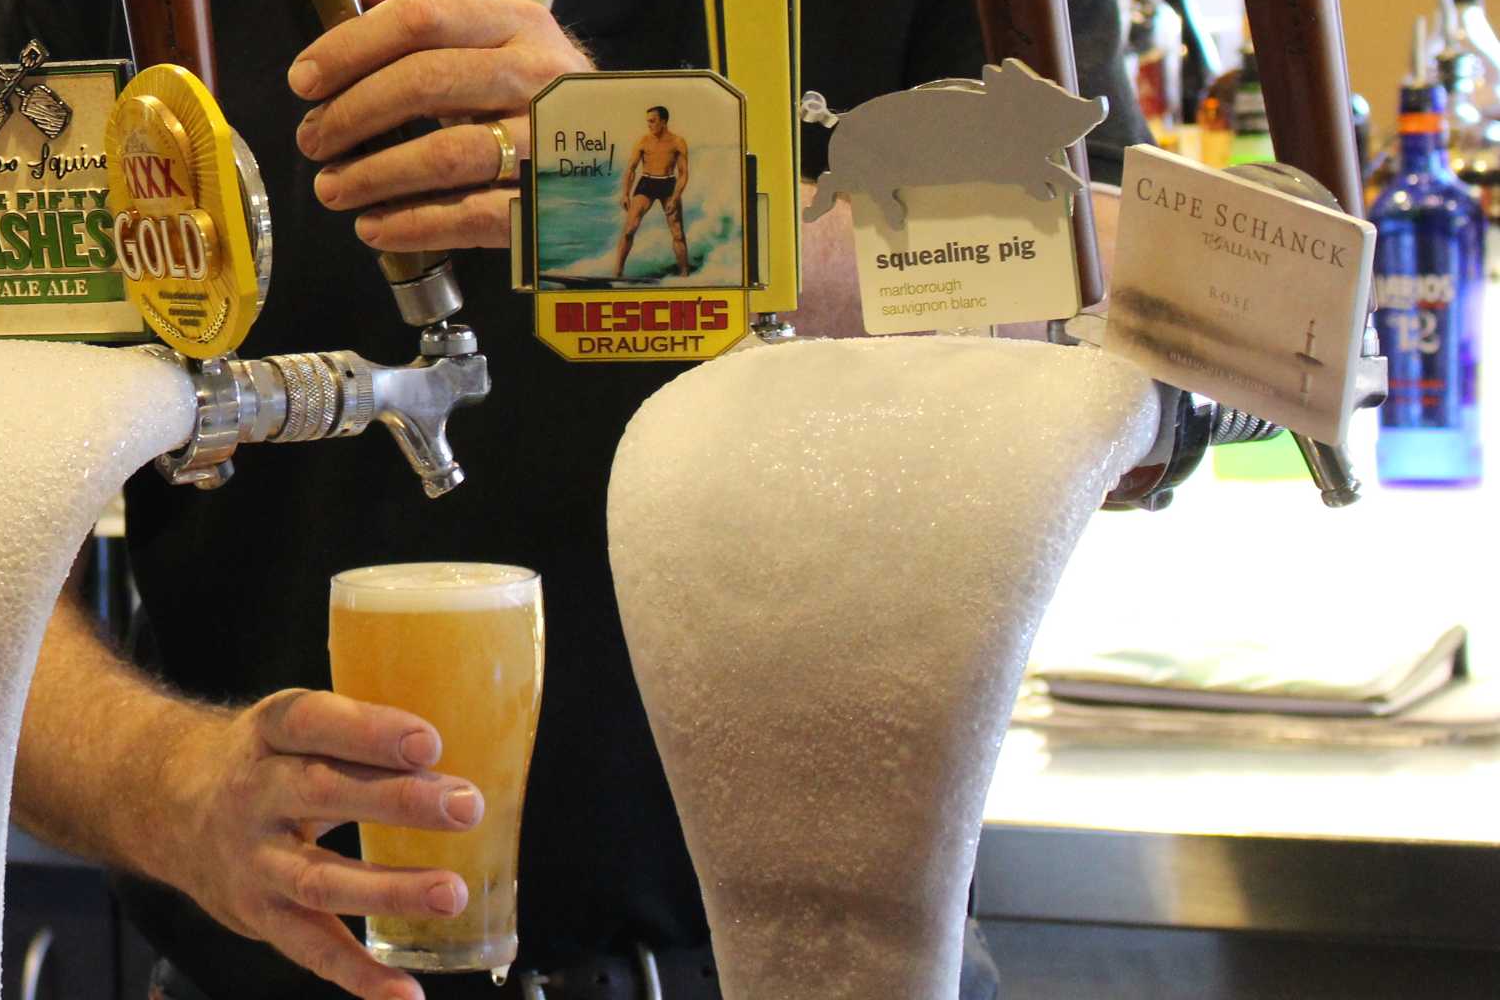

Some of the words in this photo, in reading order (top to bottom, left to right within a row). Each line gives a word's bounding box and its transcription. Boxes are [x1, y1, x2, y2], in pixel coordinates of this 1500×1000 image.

[555, 131, 566, 152] A
[576, 130, 606, 152] Real
[27, 143, 108, 180] Squire
[17, 188, 110, 210] FIFTY
[1137, 177, 1203, 220] CAPE
[1214, 203, 1348, 268] SCHANCK
[114, 210, 207, 282] GOLD
[876, 242, 990, 271] squealing
[999, 236, 1036, 262] pig
[48, 279, 88, 297] ALE
[880, 279, 962, 297] marlborough
[882, 300, 947, 316] sauvignon
[951, 296, 987, 309] blanc
[578, 335, 704, 354] DRAUGHT
